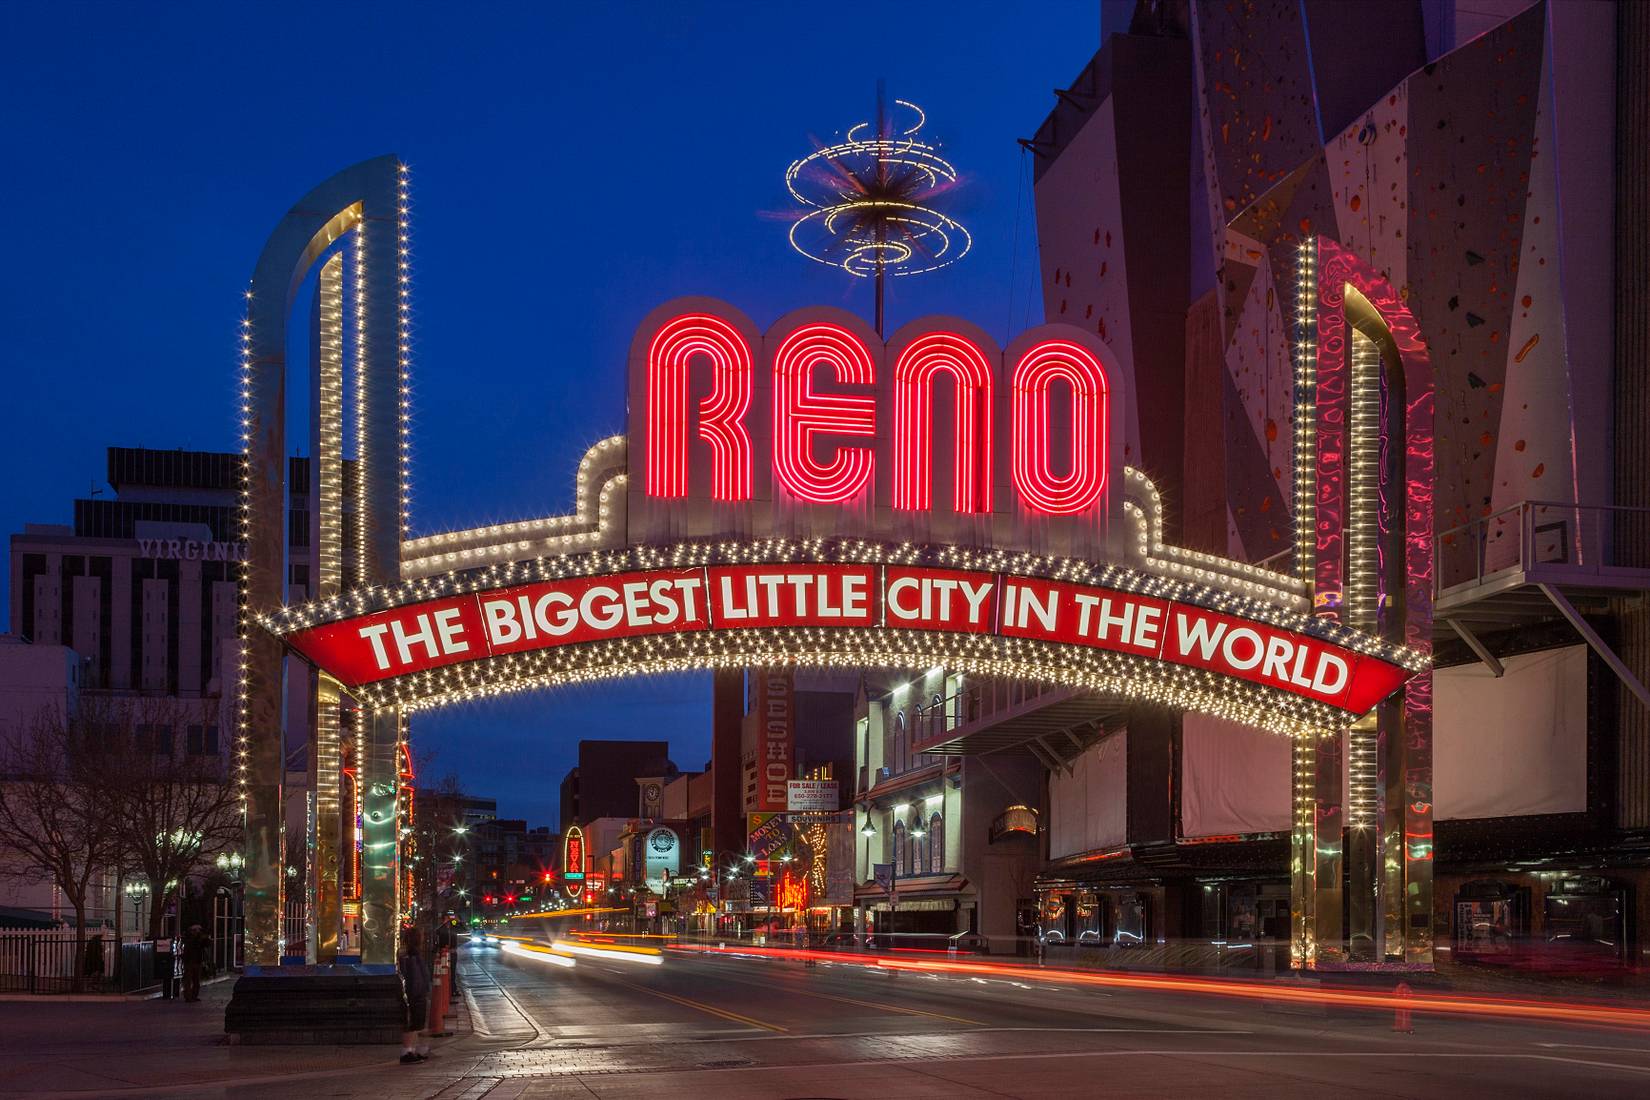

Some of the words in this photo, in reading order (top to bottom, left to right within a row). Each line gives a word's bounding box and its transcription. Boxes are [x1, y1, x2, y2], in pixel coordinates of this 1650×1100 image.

[646, 313, 1109, 514] RENO
[359, 607, 470, 670] THE
[484, 578, 702, 646] BIGGEST
[721, 575, 867, 619] LITTLE
[888, 577, 993, 624] CITY
[1004, 586, 1059, 632] IN
[1075, 594, 1161, 649] THE
[1177, 613, 1348, 695] WORLD
[750, 814, 783, 842] MONEY
[791, 815, 837, 823] SOUVENIRS
[767, 828, 781, 840] TO
